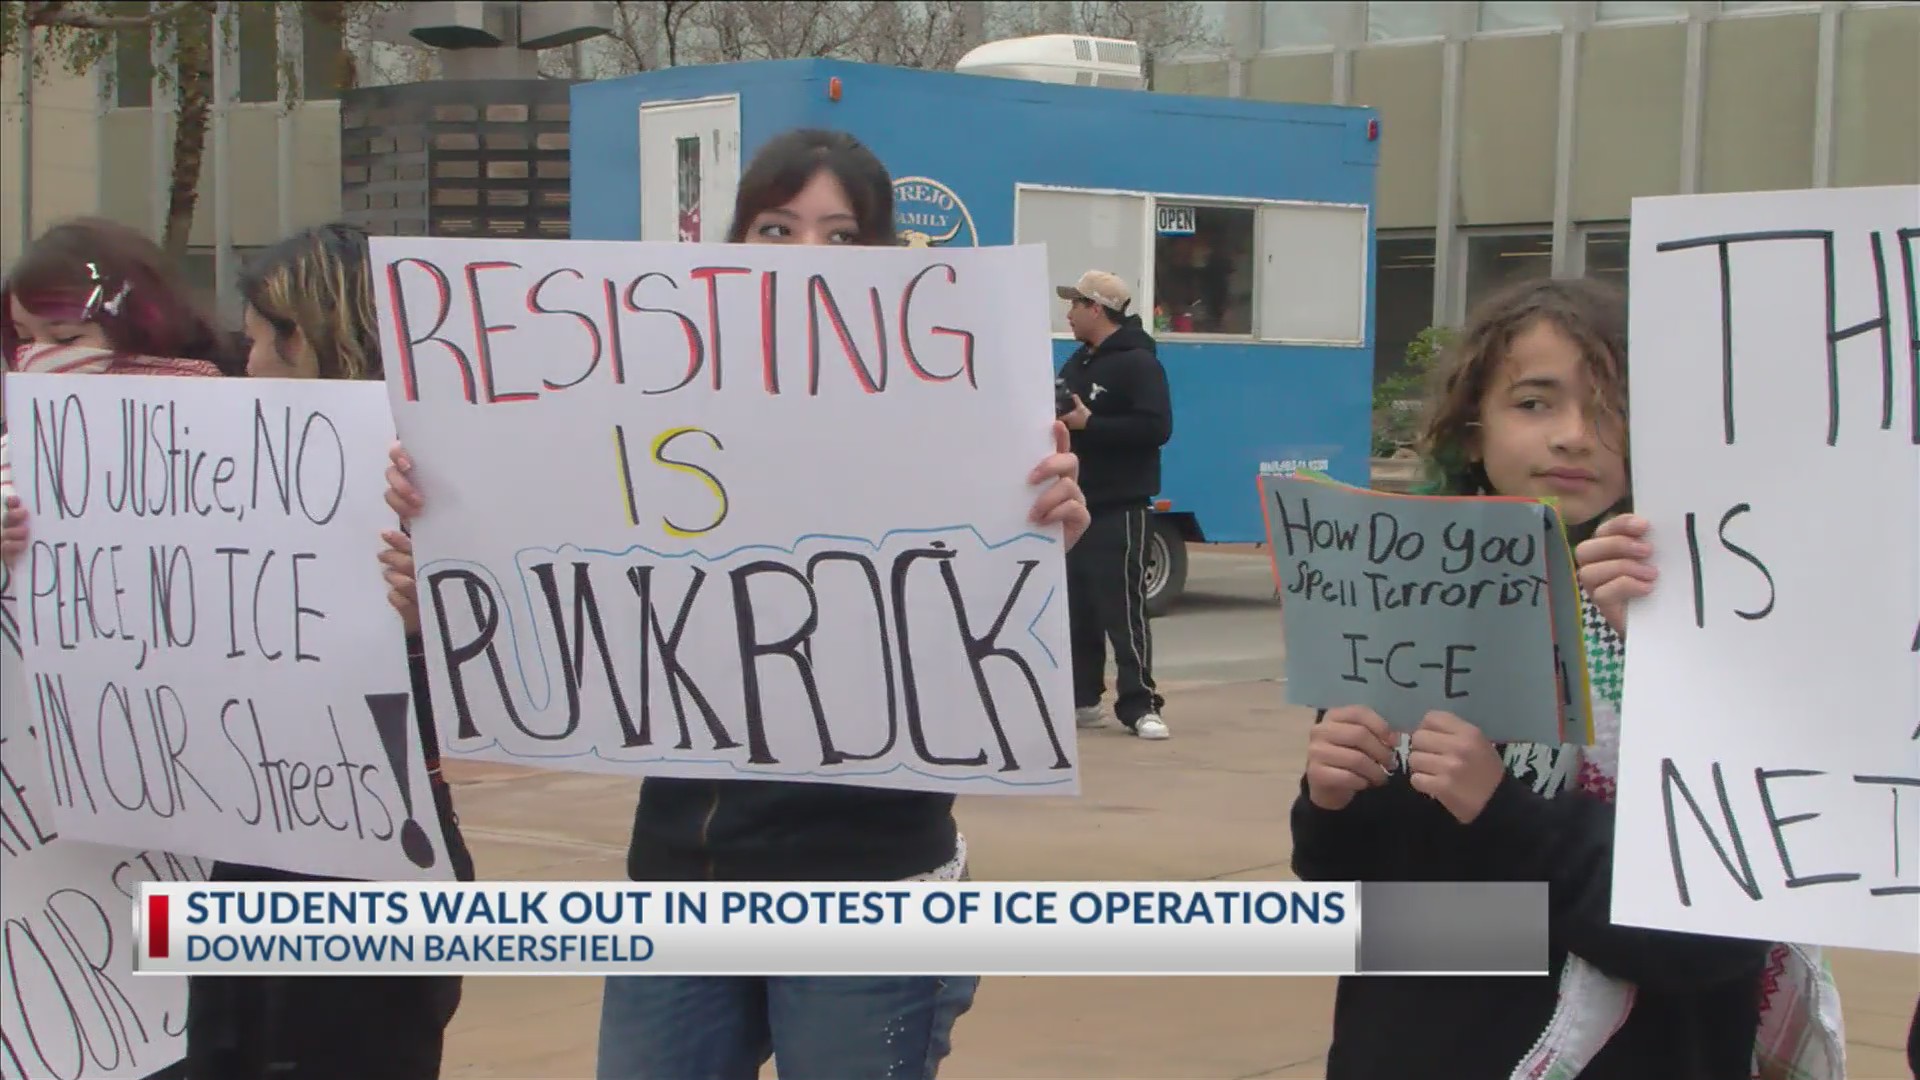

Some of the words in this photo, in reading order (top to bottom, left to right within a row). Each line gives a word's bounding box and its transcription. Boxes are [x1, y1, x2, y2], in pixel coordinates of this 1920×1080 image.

[894, 185, 954, 210] REJO
[896, 211, 951, 227] AMILY
[1158, 207, 1194, 231] OPEN
[387, 257, 979, 405] RESISTING
[33, 394, 90, 519] NO
[252, 398, 345, 525] NO
[614, 424, 729, 538] IS
[1275, 491, 1360, 557] How
[1367, 511, 1425, 565] Do
[1686, 503, 1775, 628] IS
[31, 541, 147, 669] PEACE,
[149, 545, 195, 648] NO
[216, 548, 325, 662] ICE
[1287, 560, 1357, 607] Spell
[1340, 632, 1477, 699] I-C-E
[35, 673, 98, 815] IN
[98, 682, 222, 818] OUR
